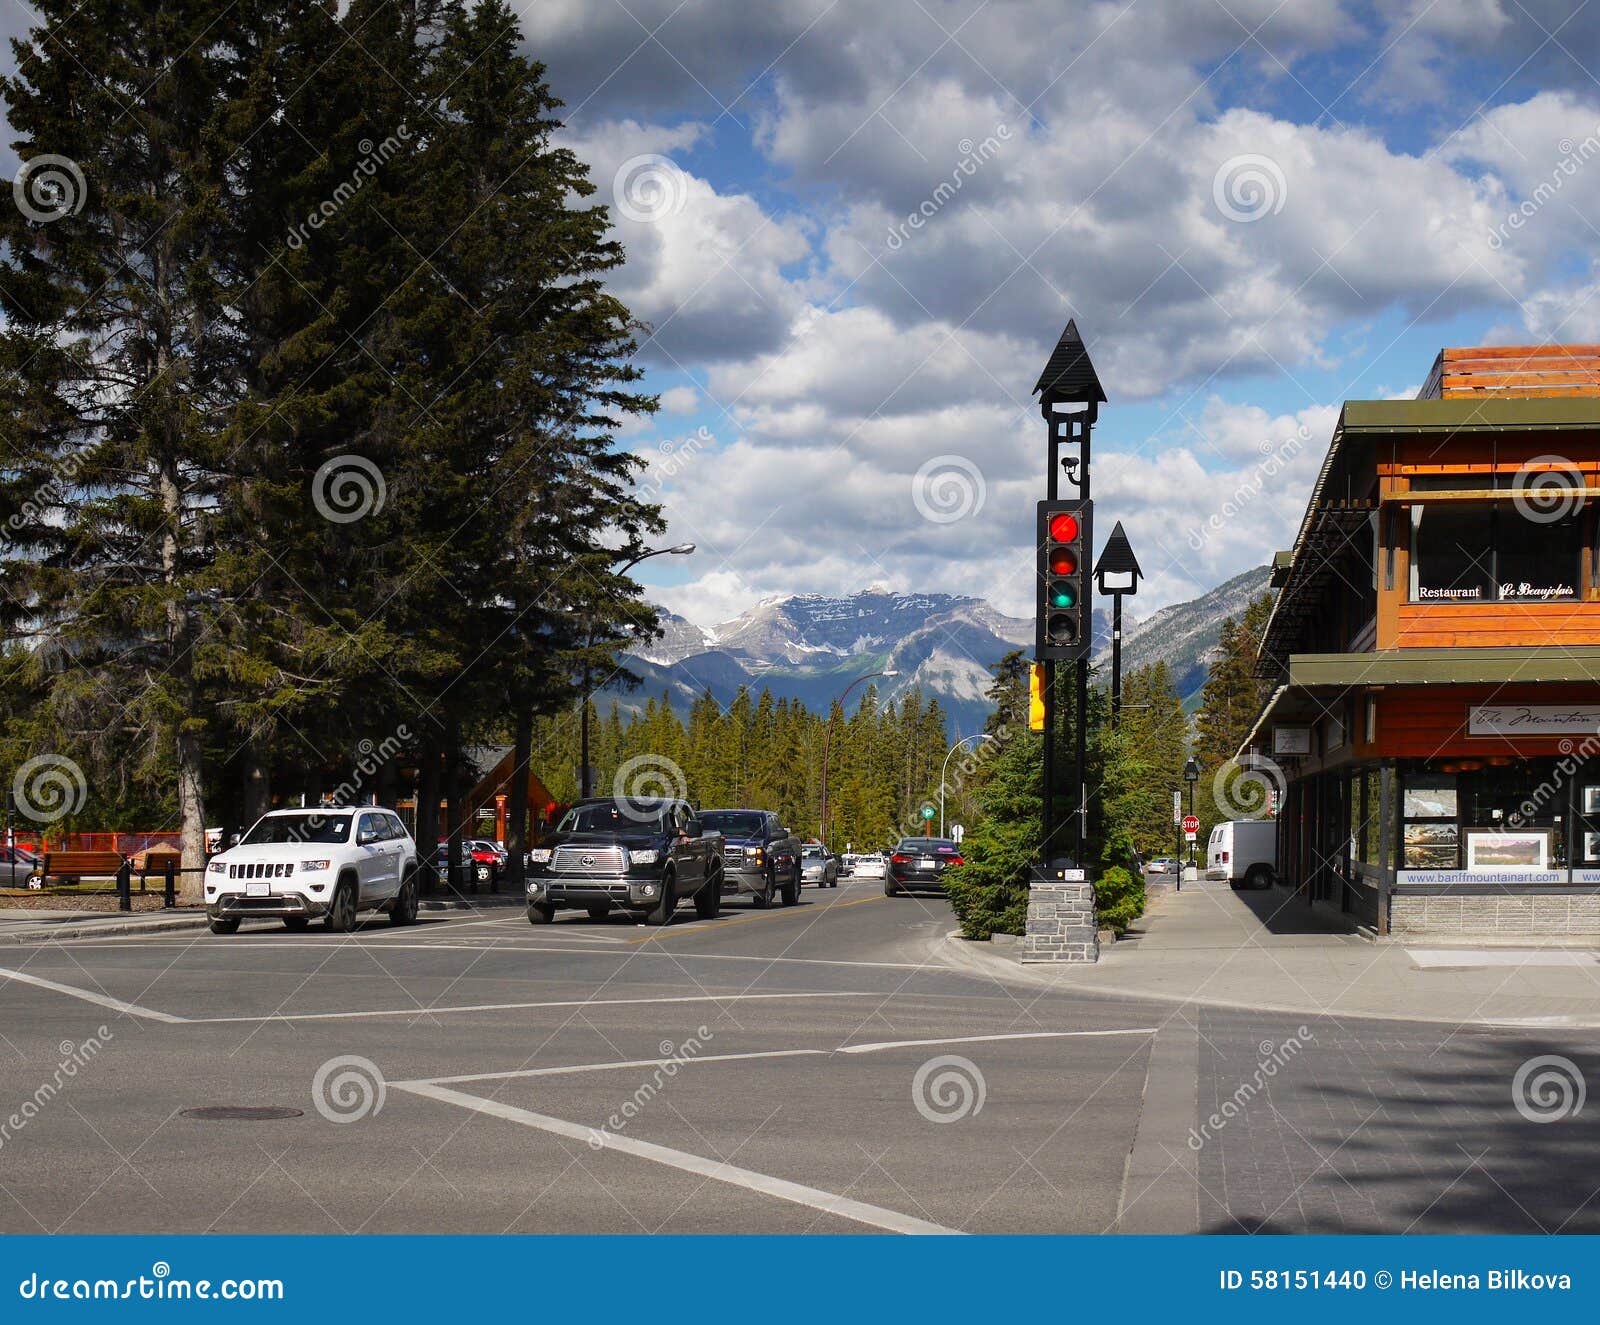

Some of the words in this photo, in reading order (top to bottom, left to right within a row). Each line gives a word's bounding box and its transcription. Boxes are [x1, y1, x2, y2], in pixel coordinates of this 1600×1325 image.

[1419, 586, 1480, 598] Restaurant
[1500, 582, 1515, 596] Le
[1516, 581, 1574, 600] Beaujolais
[1507, 707, 1593, 726] Mountain
[1182, 820, 1200, 829] STOP
[1407, 871, 1560, 883] www.banffmountainart.com
